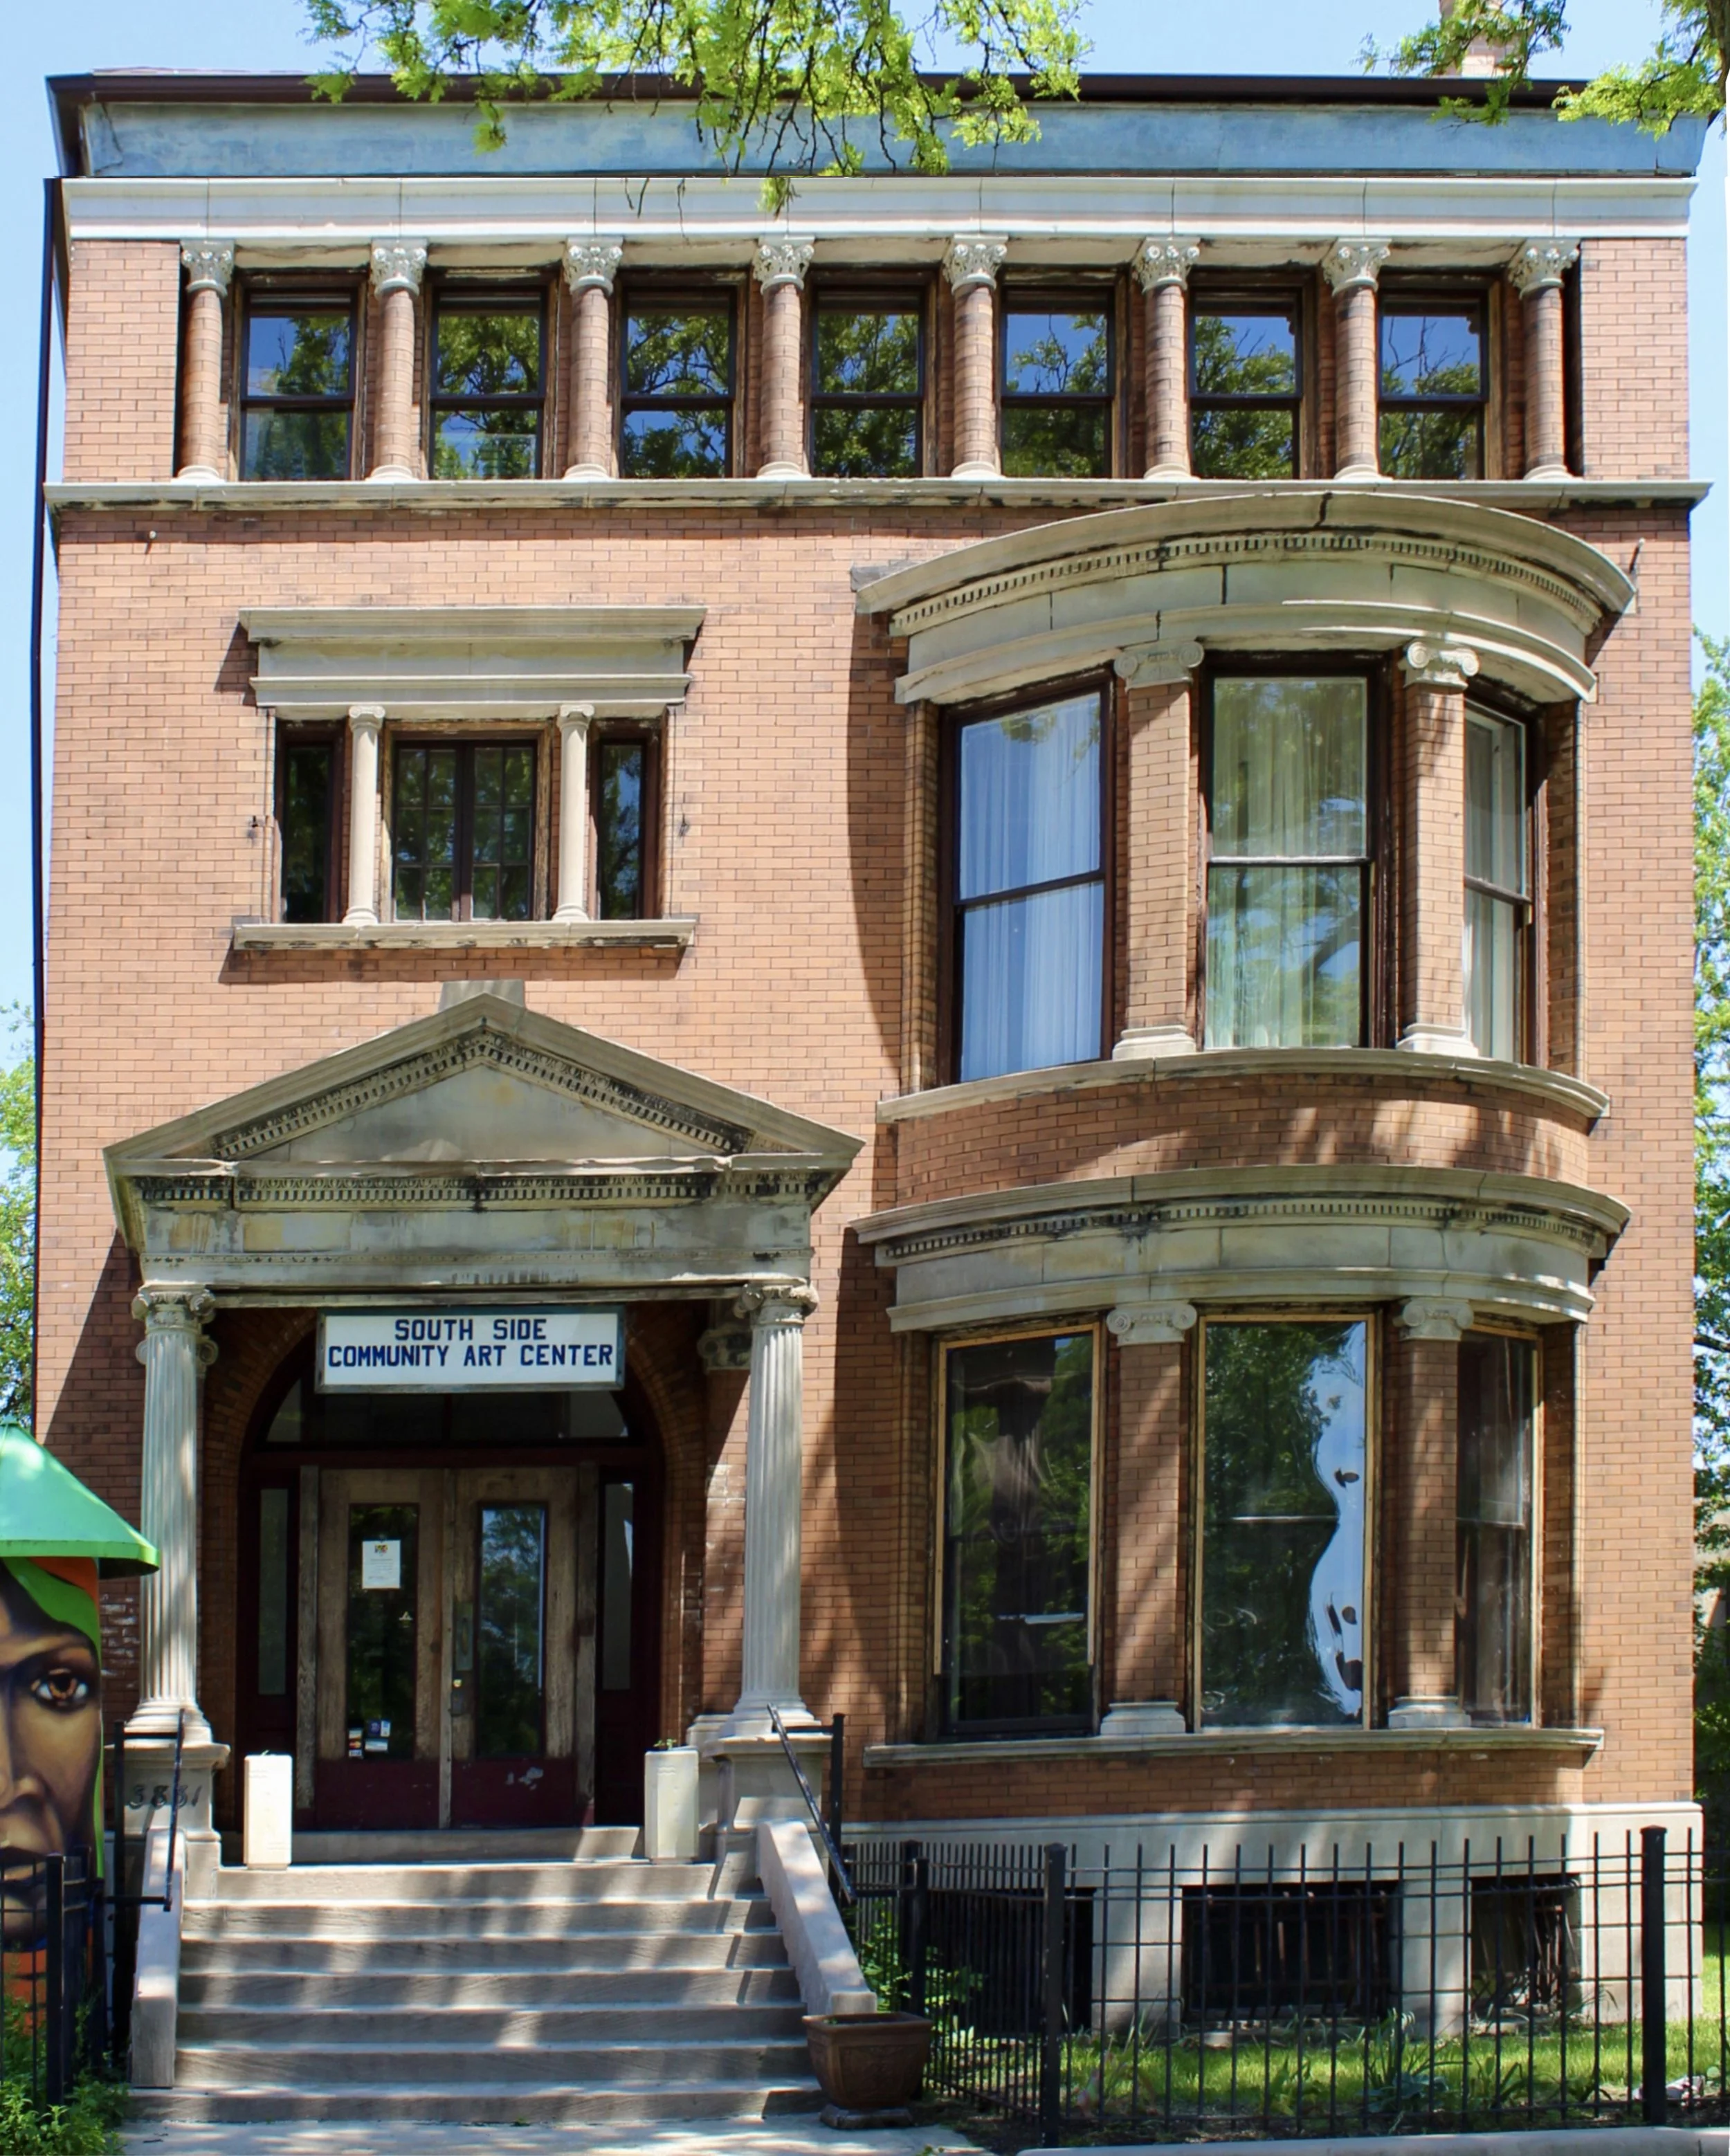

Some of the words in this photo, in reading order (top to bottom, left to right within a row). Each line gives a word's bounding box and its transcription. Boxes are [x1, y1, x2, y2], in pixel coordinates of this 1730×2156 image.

[394, 1319, 473, 1341] SOUTH
[493, 1318, 547, 1341] SIDE
[328, 1344, 449, 1367] COMMUNITY
[463, 1344, 507, 1367] ART
[520, 1344, 613, 1367] CENTER
